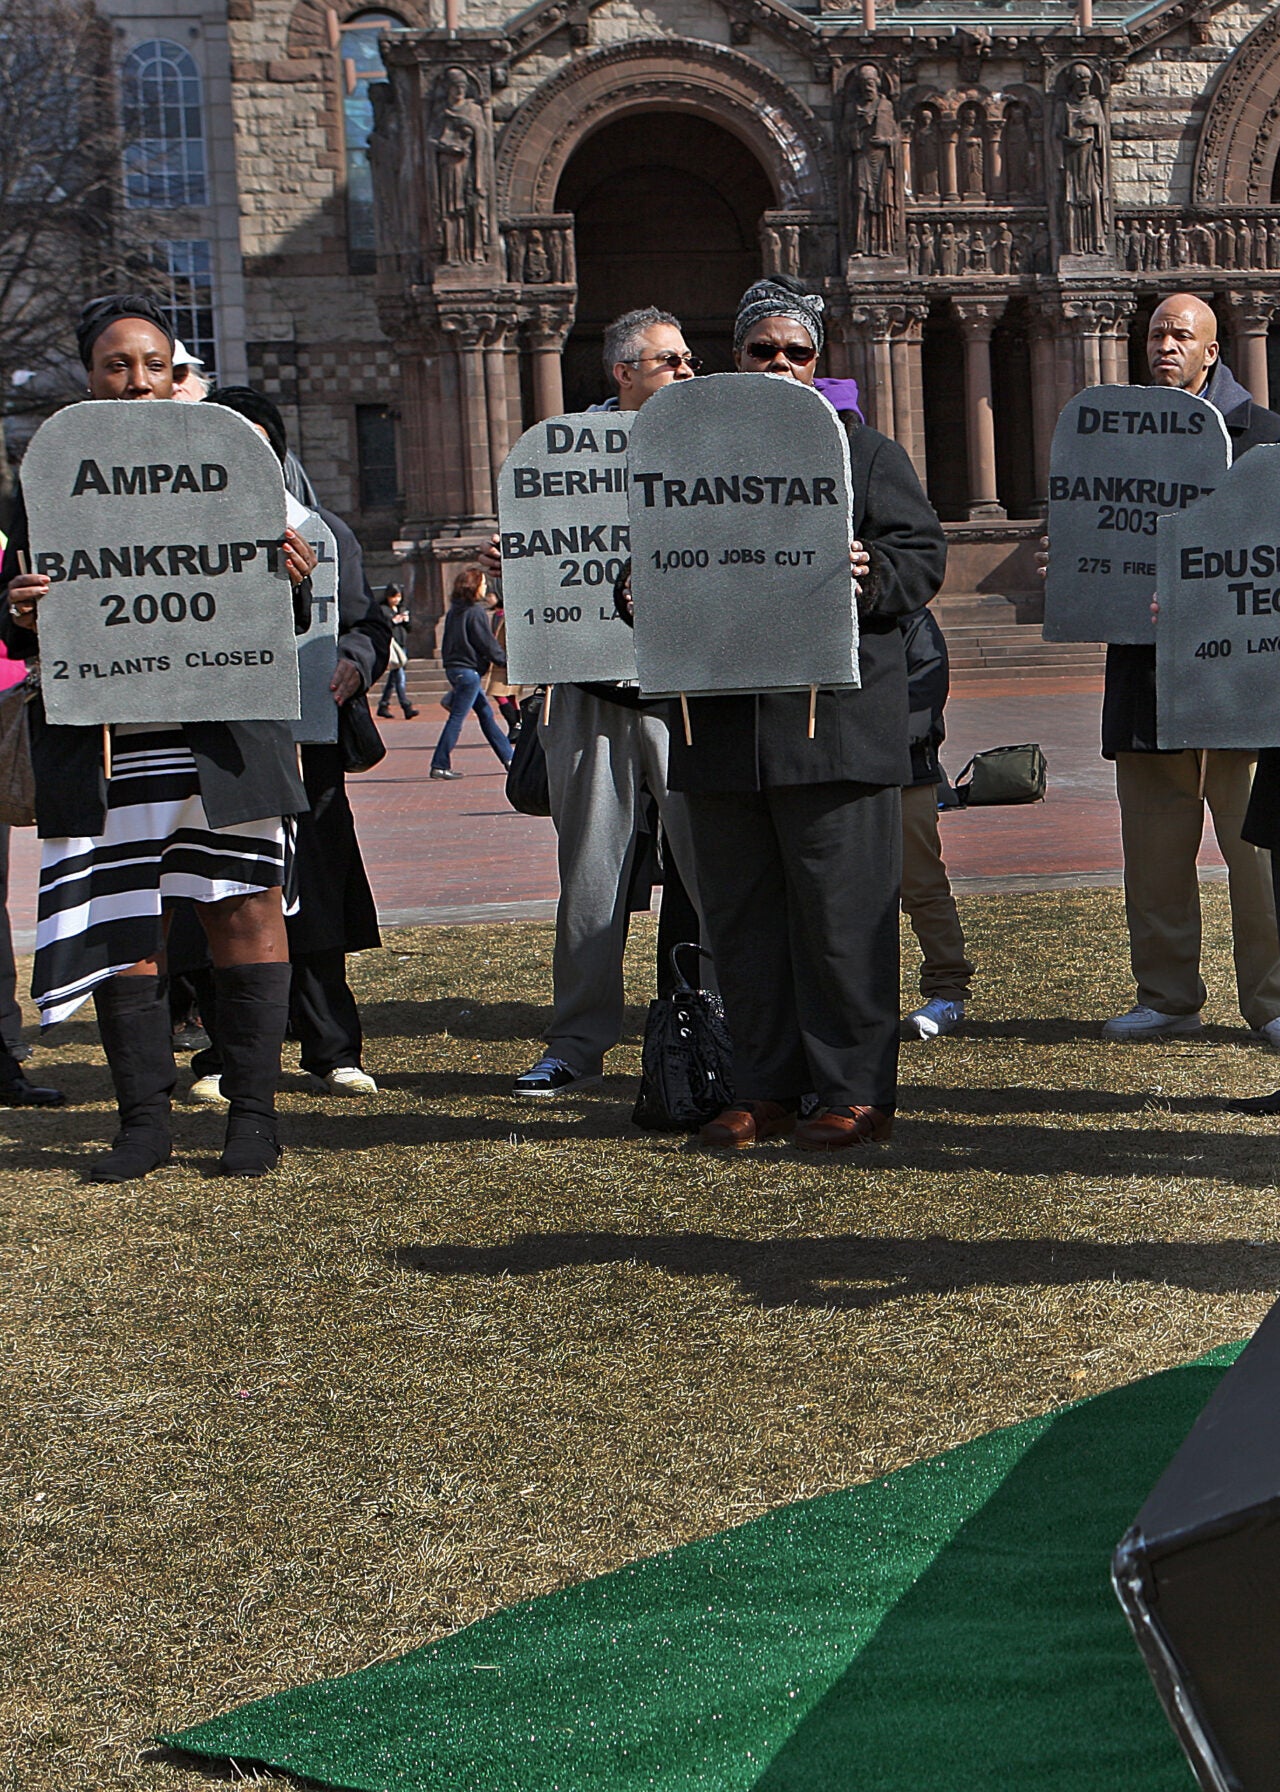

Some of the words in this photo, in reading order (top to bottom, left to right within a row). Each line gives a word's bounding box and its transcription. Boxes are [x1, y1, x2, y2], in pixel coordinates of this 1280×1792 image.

[1077, 406, 1206, 434] DETAILS
[71, 459, 228, 497] AMPAD
[634, 473, 838, 508] TRANSTAR
[1097, 505, 1157, 535] 2003
[36, 540, 286, 582] BANKRUPT
[651, 549, 709, 573] 1,000
[718, 549, 766, 566] JOBS
[774, 551, 816, 566] CUT
[1078, 557, 1112, 575] 275
[1123, 561, 1157, 576] FIRE
[100, 592, 216, 627] 2000
[1195, 639, 1232, 660] 400
[52, 660, 70, 680] 2
[79, 655, 171, 680] PLANTS
[185, 650, 275, 669] CLOSED
